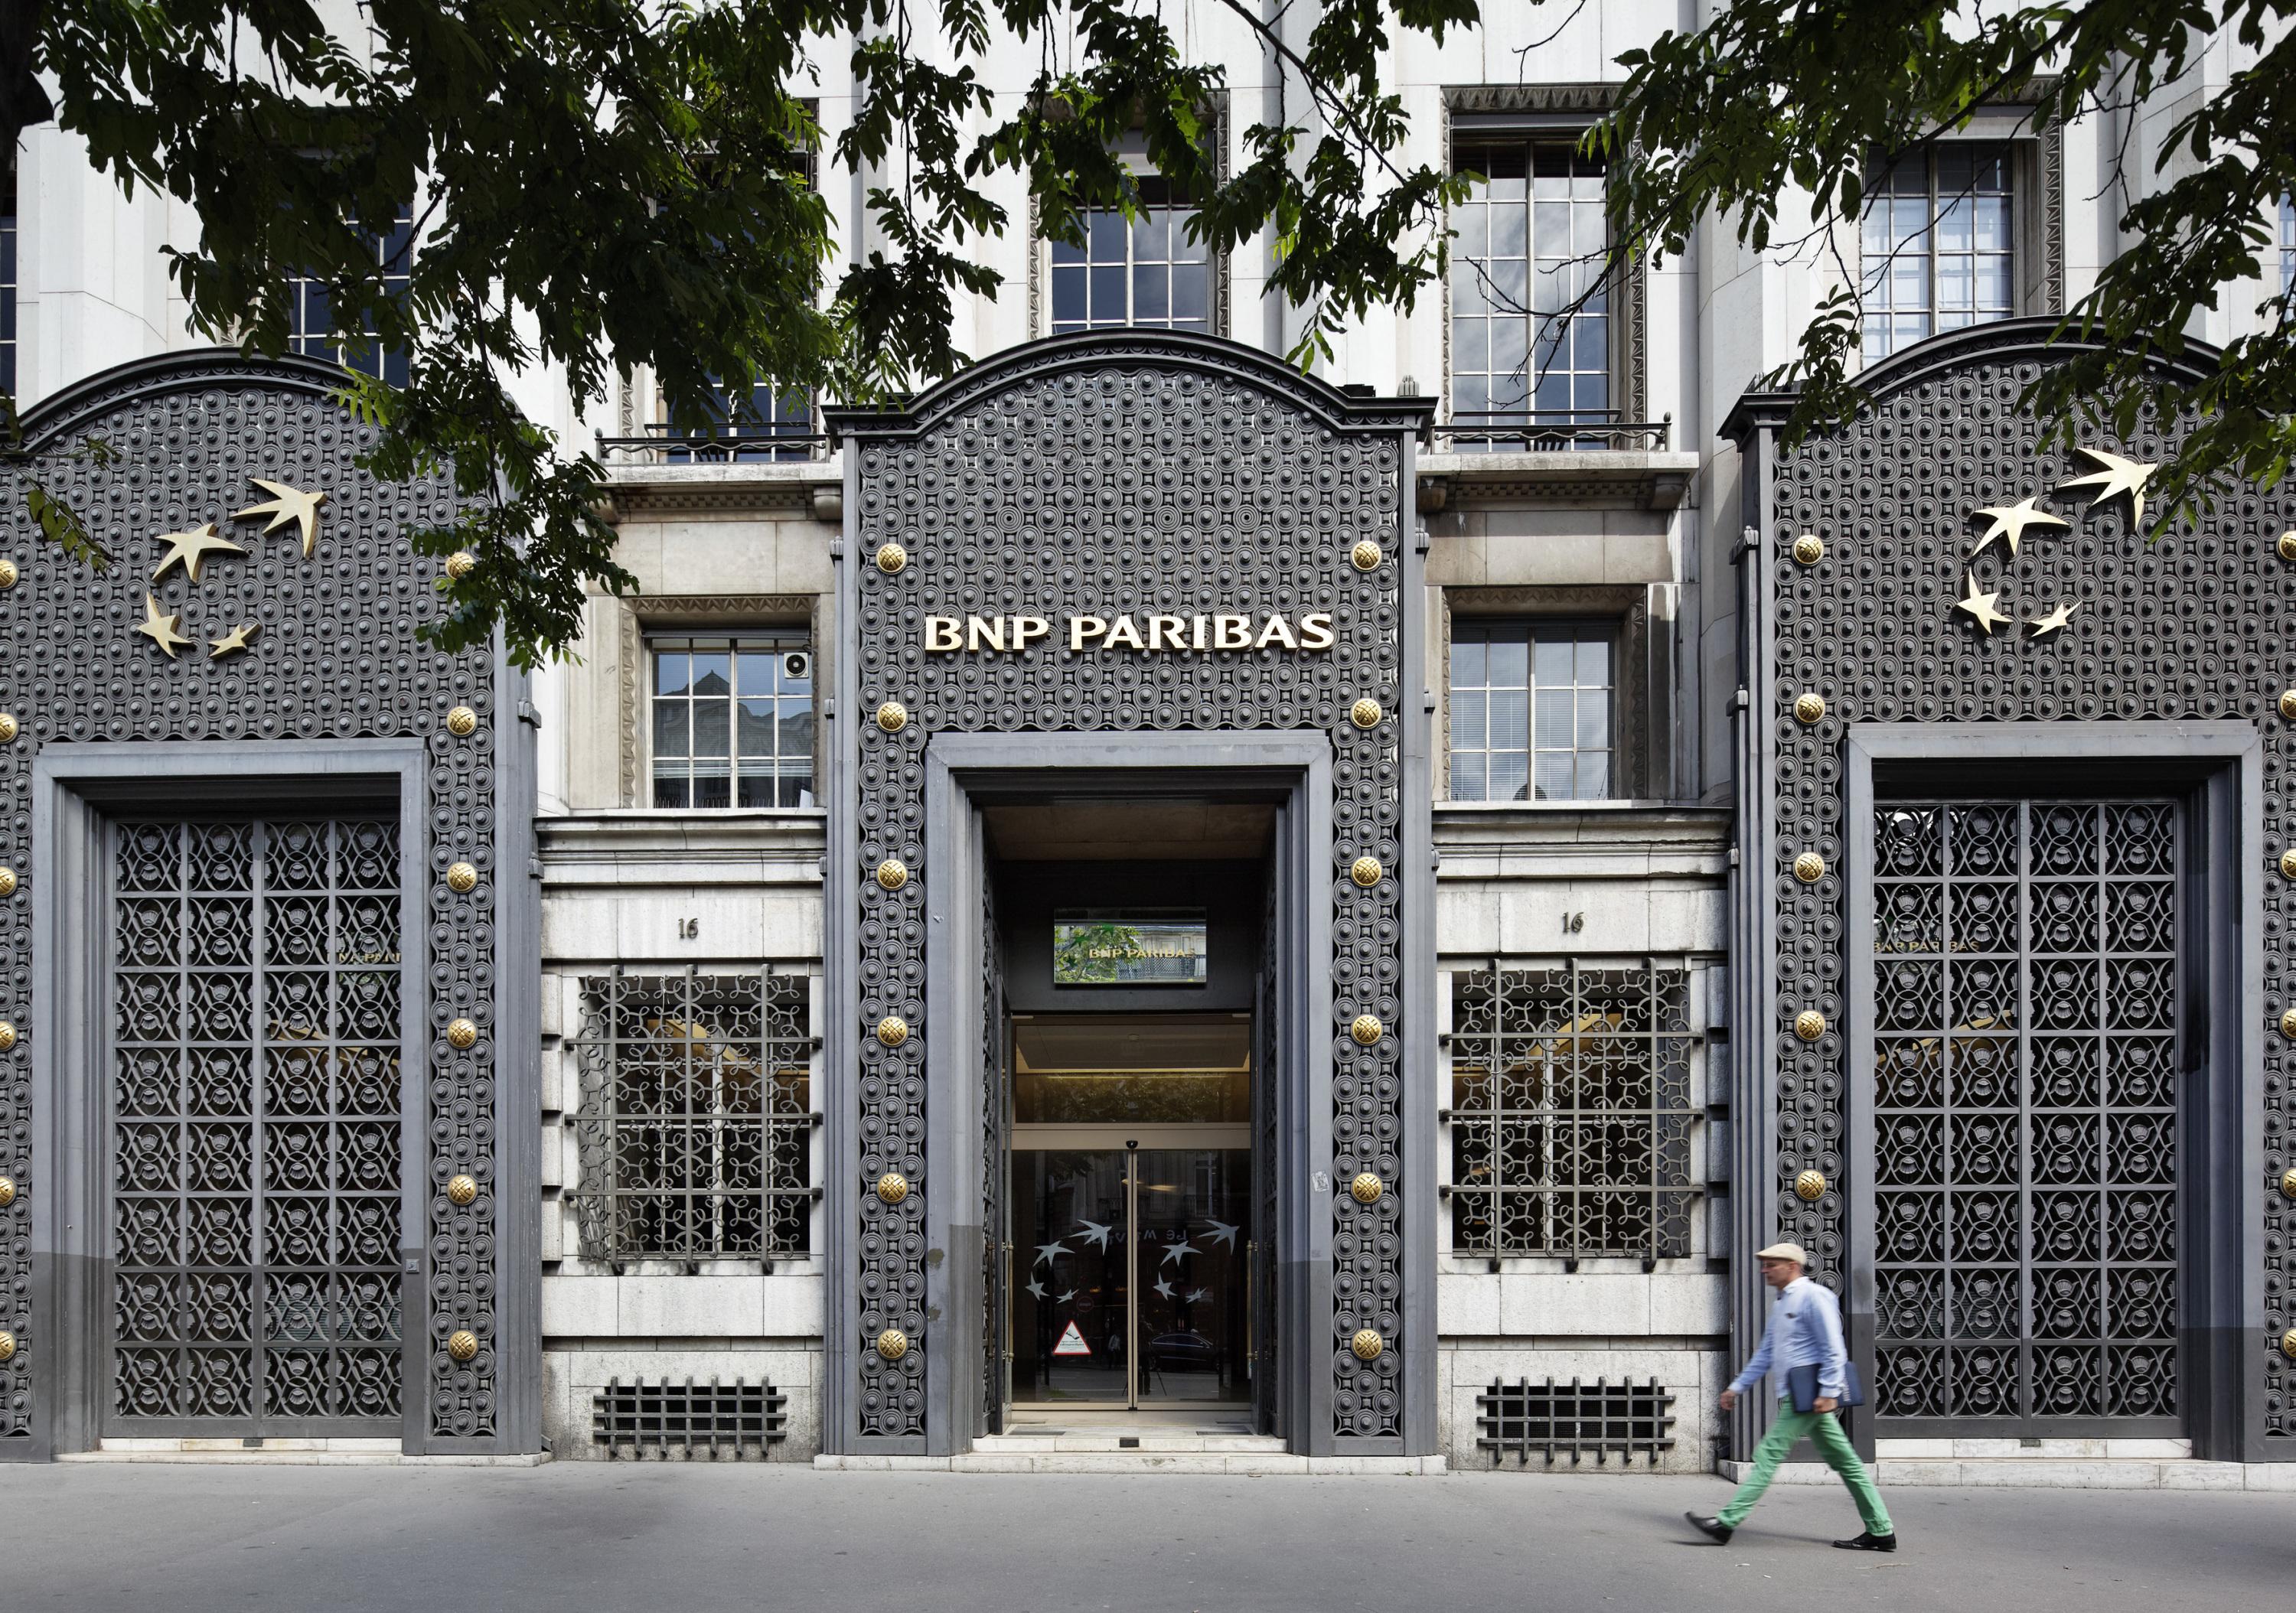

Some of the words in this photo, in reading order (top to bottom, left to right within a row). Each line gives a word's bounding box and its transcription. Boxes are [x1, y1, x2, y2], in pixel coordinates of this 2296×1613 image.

[925, 616, 1049, 651] BNP
[1071, 614, 1335, 651] PARIBAS
[678, 917, 699, 940] 16
[1562, 911, 1584, 934] 16
[1088, 948, 1123, 959] BNP
[1909, 940, 1980, 952] PARBAS
